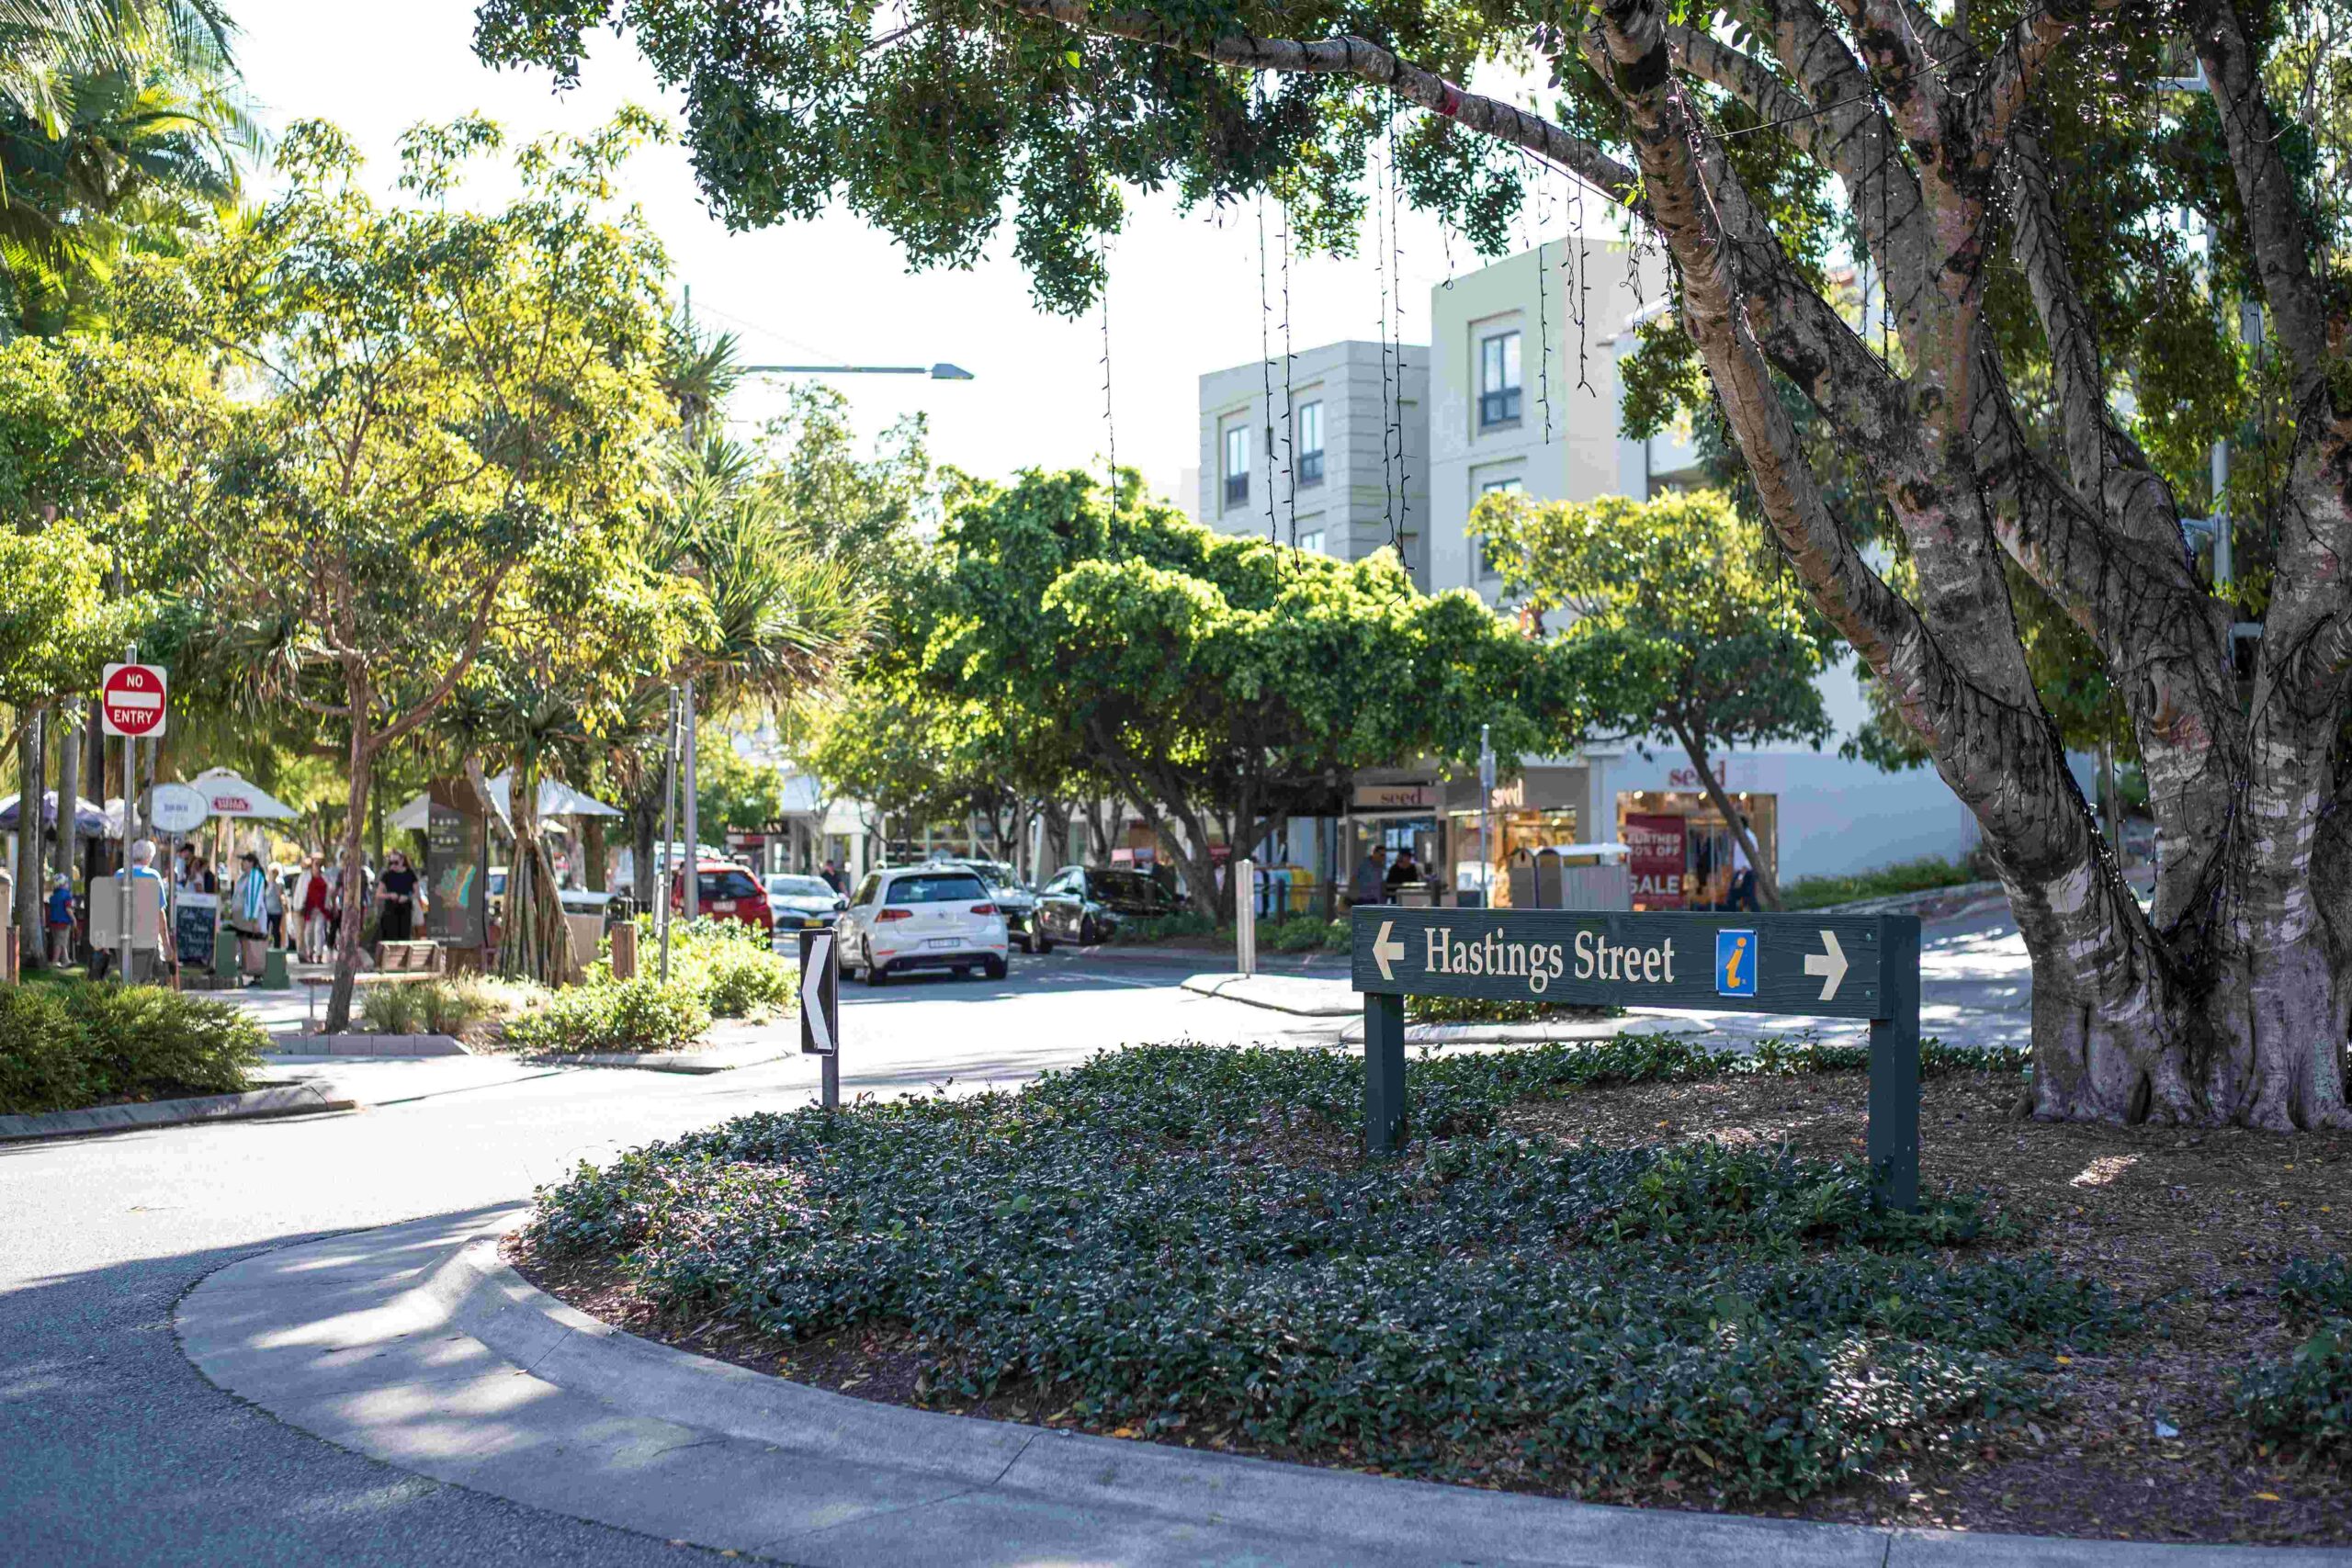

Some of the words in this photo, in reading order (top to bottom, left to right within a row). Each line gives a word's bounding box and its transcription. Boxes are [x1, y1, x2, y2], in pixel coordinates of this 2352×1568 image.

[127, 674, 143, 688] NO
[114, 709, 153, 724] ENTRY
[1669, 761, 1725, 787] sed
[1380, 784, 1421, 805] seed
[1627, 833, 1681, 844] FURTHER
[1657, 845, 1680, 857] OFF
[1629, 874, 1680, 895] SALE
[1424, 927, 1564, 994] Hastings
[1575, 930, 1675, 983] Street
